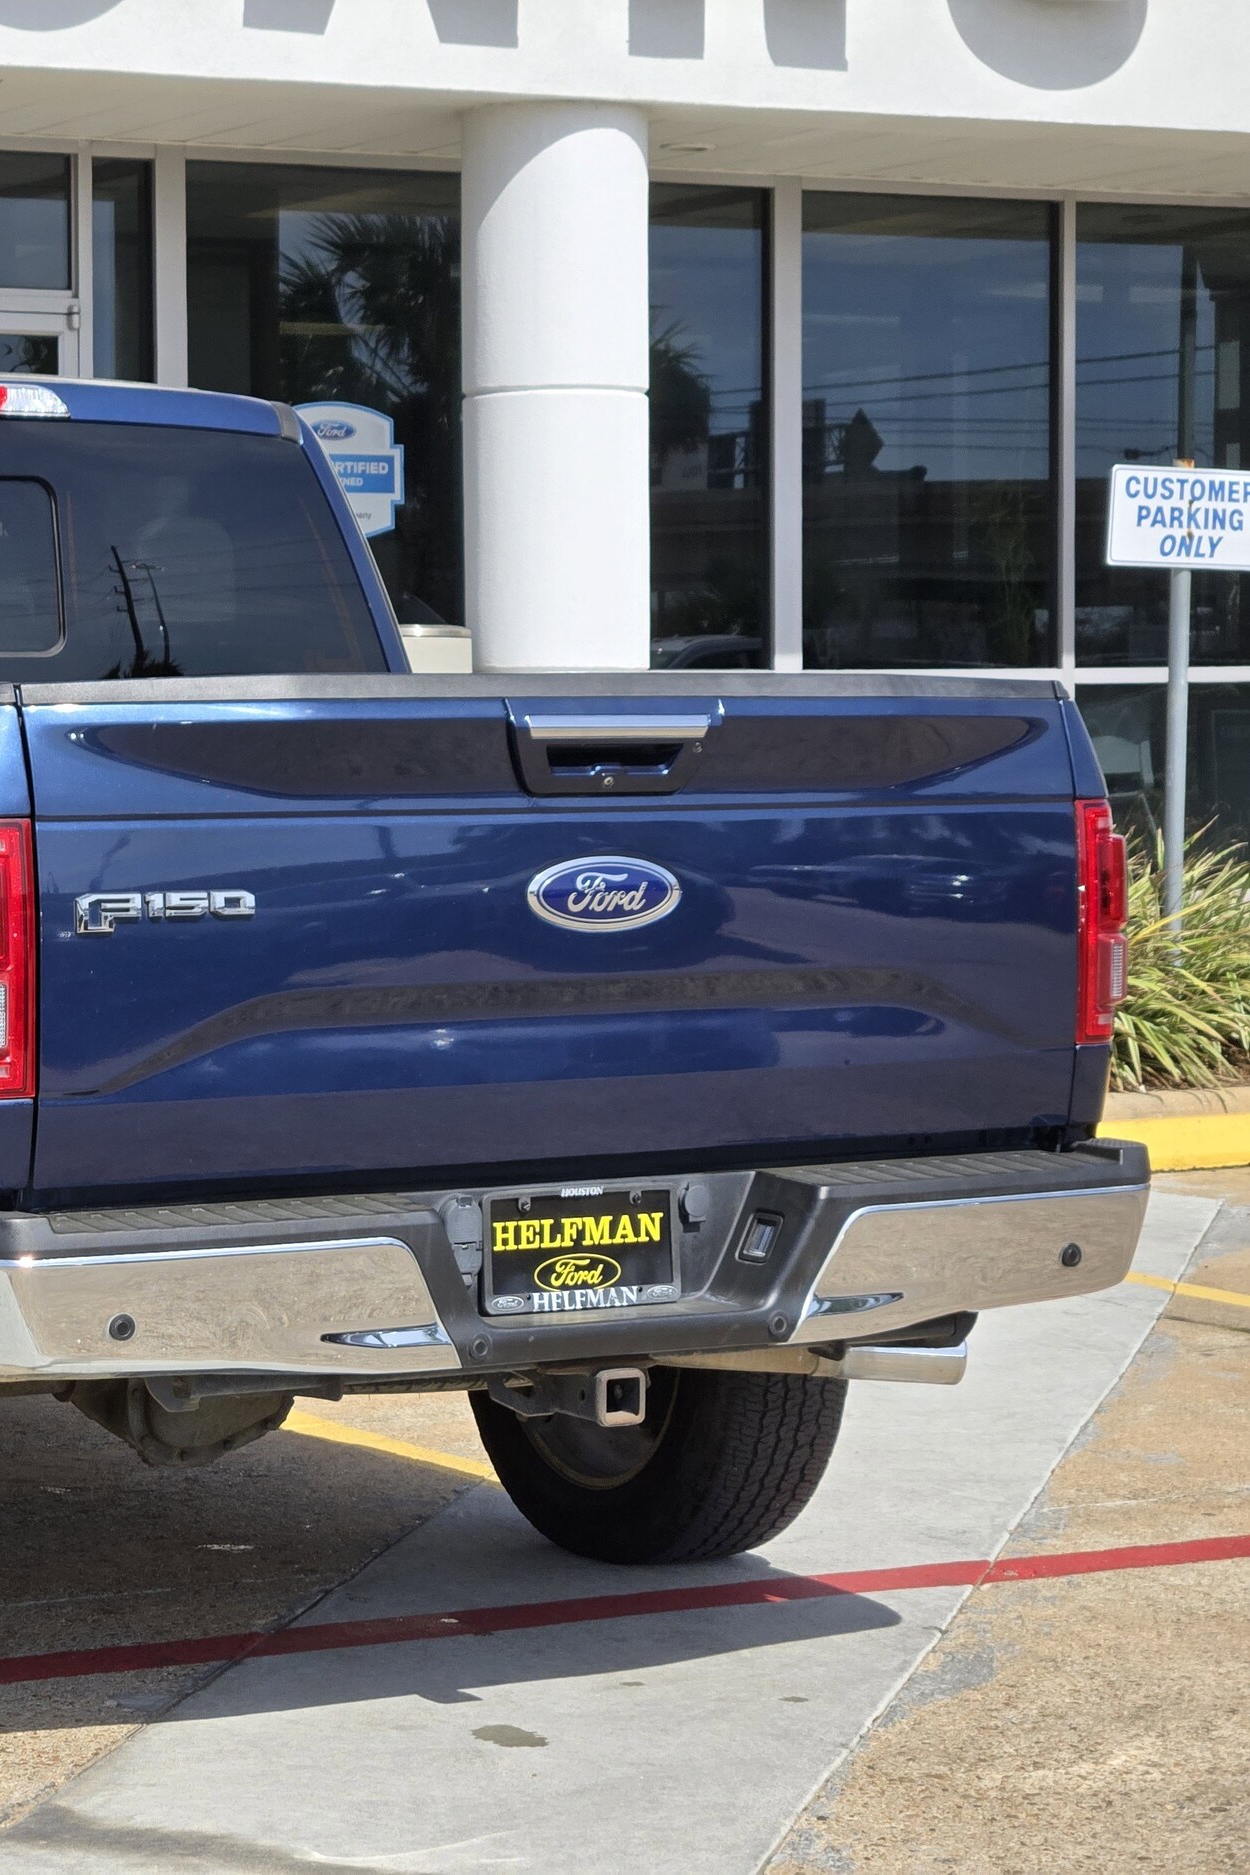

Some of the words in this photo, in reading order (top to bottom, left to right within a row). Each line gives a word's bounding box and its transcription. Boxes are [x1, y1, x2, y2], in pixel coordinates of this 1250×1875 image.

[332, 461, 389, 474] RTIFIED
[1136, 505, 1244, 531] PARKING
[1159, 534, 1223, 558] ONLY
[567, 872, 649, 912] Ford
[561, 1186, 605, 1198] HOUSTON
[492, 1212, 664, 1252] HELFMAN
[550, 1259, 604, 1287] Ford
[532, 1286, 639, 1312] HELFMAN
